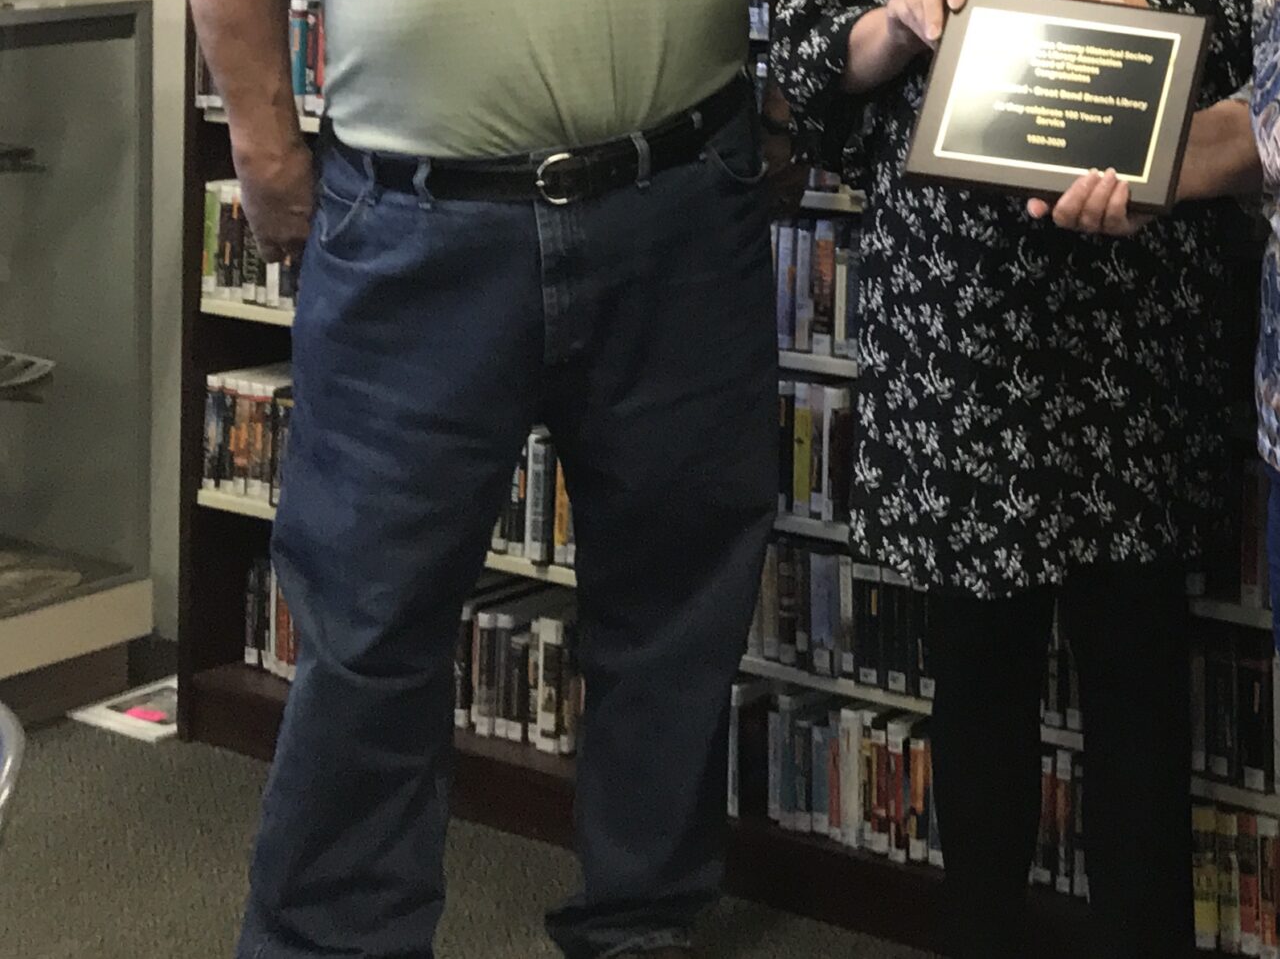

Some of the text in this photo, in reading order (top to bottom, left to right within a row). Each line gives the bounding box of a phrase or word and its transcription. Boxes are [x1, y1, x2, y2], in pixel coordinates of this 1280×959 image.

[1124, 50, 1154, 64] Society
[1033, 85, 1059, 98] Great
[1059, 89, 1083, 101] Bend
[1083, 92, 1115, 105] Branch
[1116, 96, 1148, 111] Library
[1079, 111, 1102, 124] Years
